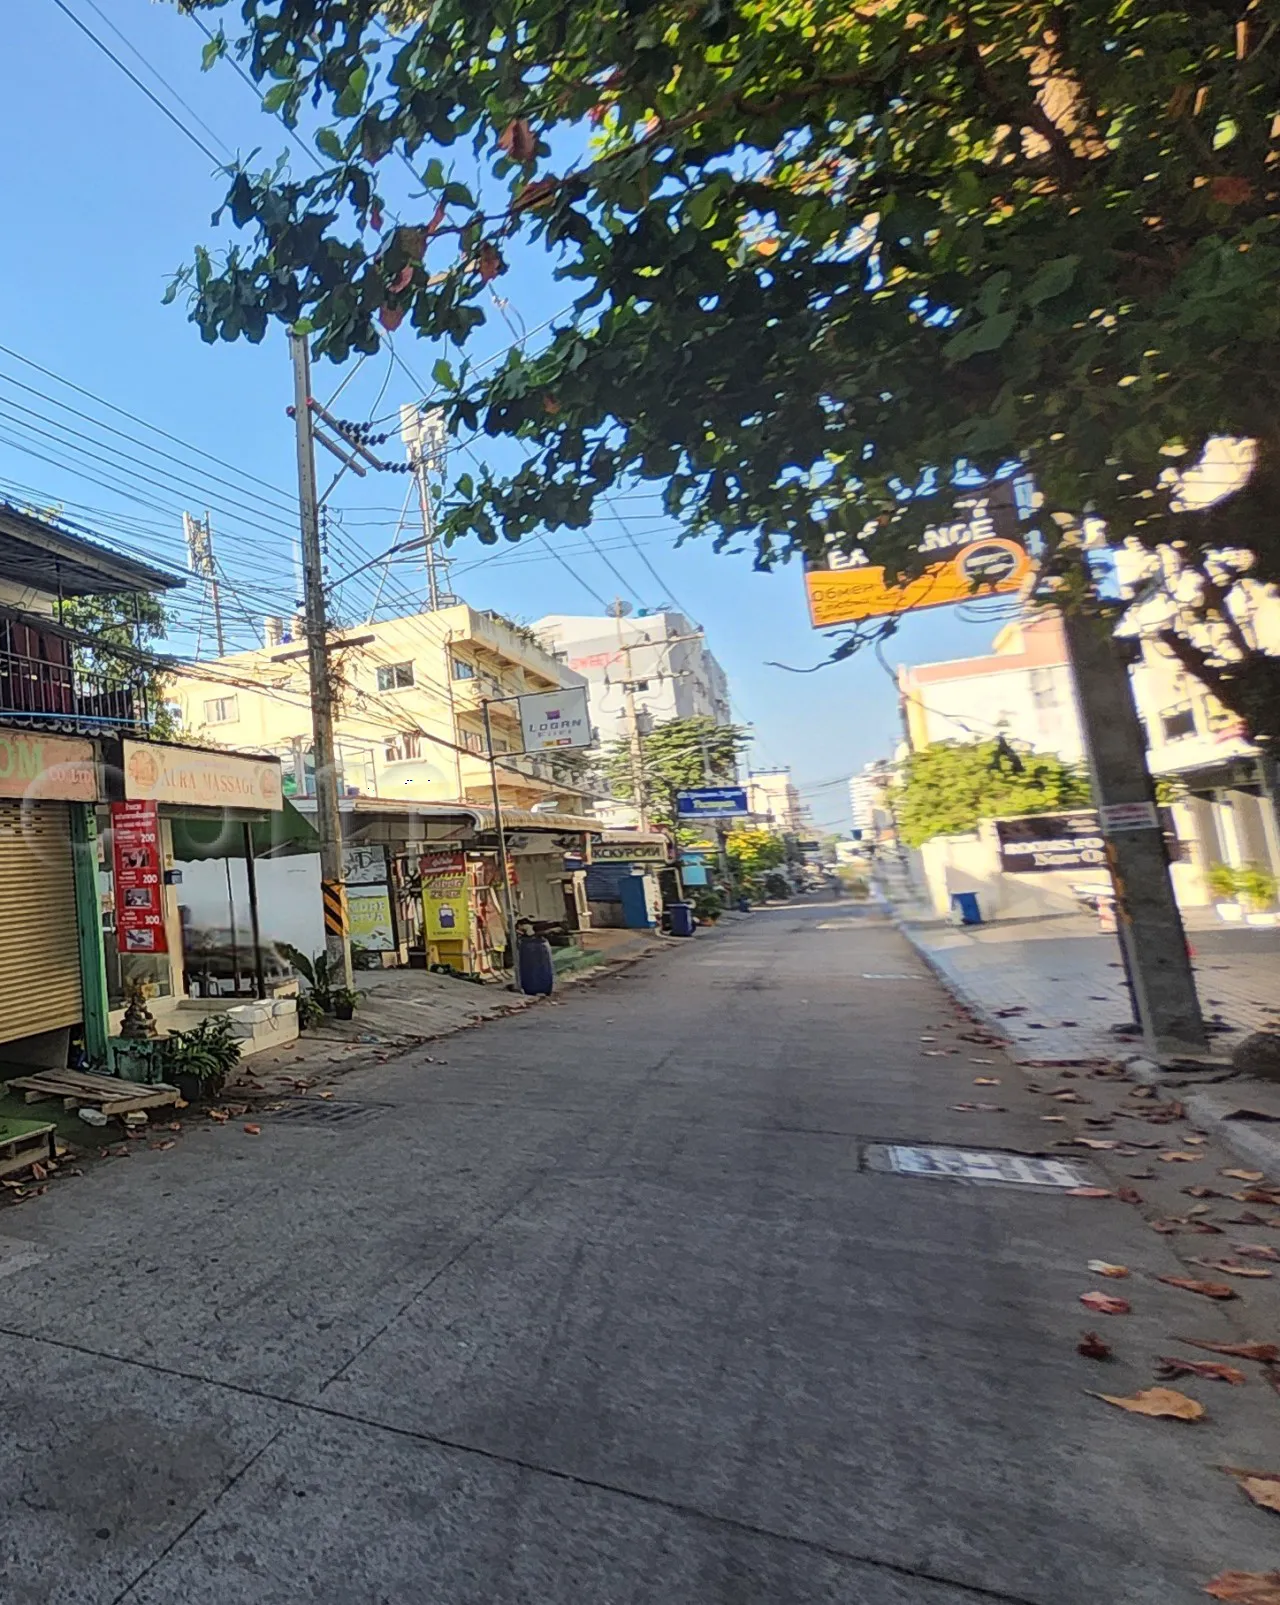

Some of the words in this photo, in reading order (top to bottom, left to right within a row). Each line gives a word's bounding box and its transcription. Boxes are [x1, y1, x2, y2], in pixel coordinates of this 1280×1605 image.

[529, 719, 582, 732] LOGAN
[161, 767, 197, 790] AURA
[202, 772, 256, 796] MASSAGE
[141, 833, 155, 843] 200
[592, 847, 661, 858] КСКУРСИИ
[143, 874, 158, 883] 200
